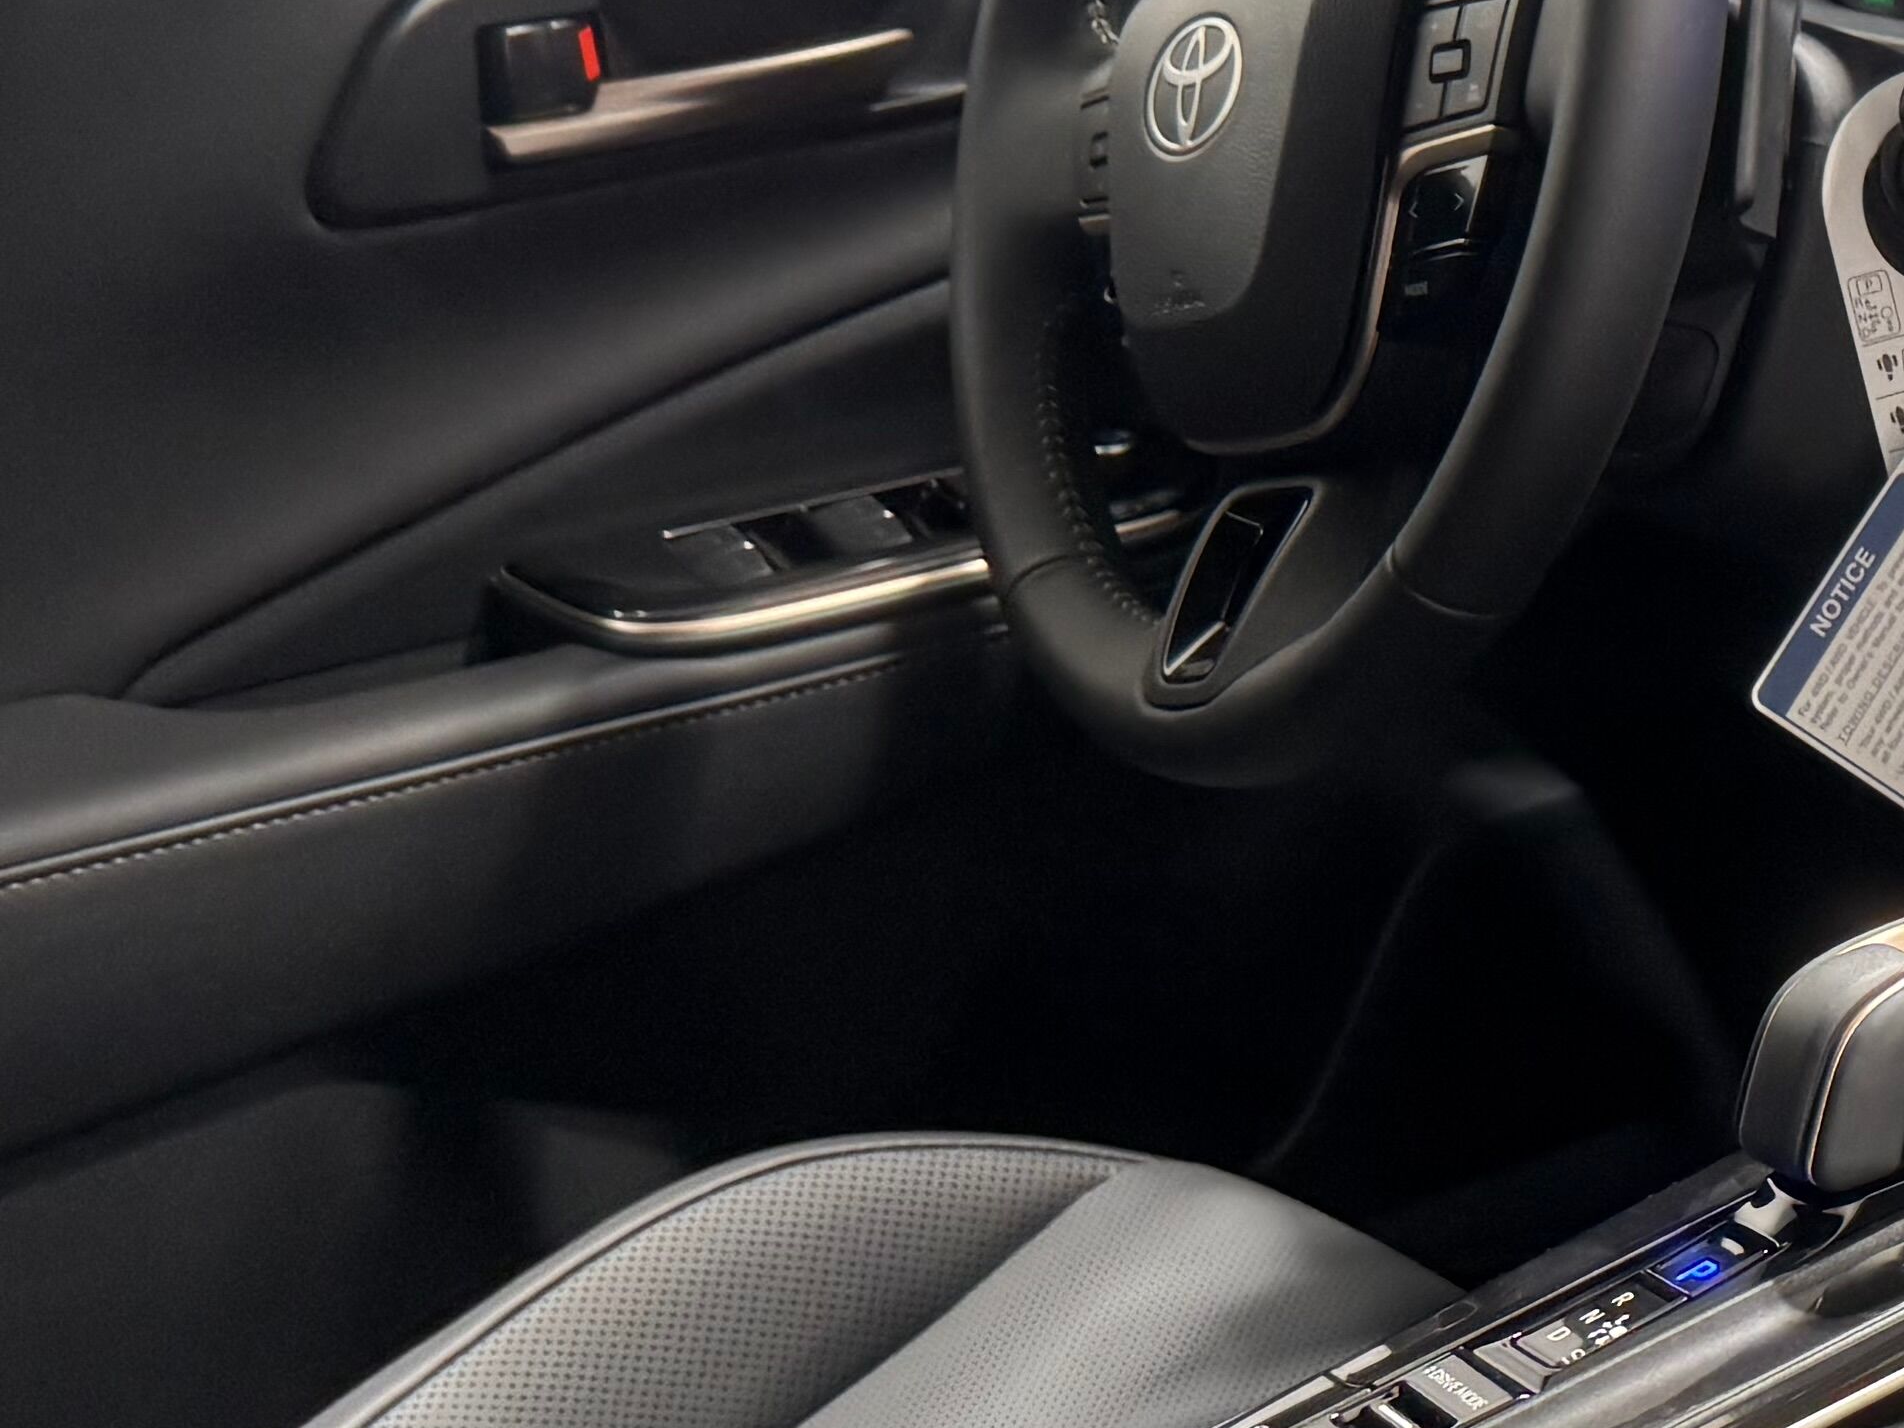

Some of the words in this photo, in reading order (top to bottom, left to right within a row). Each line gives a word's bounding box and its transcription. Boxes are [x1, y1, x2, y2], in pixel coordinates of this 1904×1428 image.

[1808, 544, 1877, 638] NOTICE
[1675, 1259, 1721, 1282] P
[1611, 1291, 1634, 1307] R
[1579, 1309, 1605, 1325] N
[1547, 1325, 1572, 1341] D
